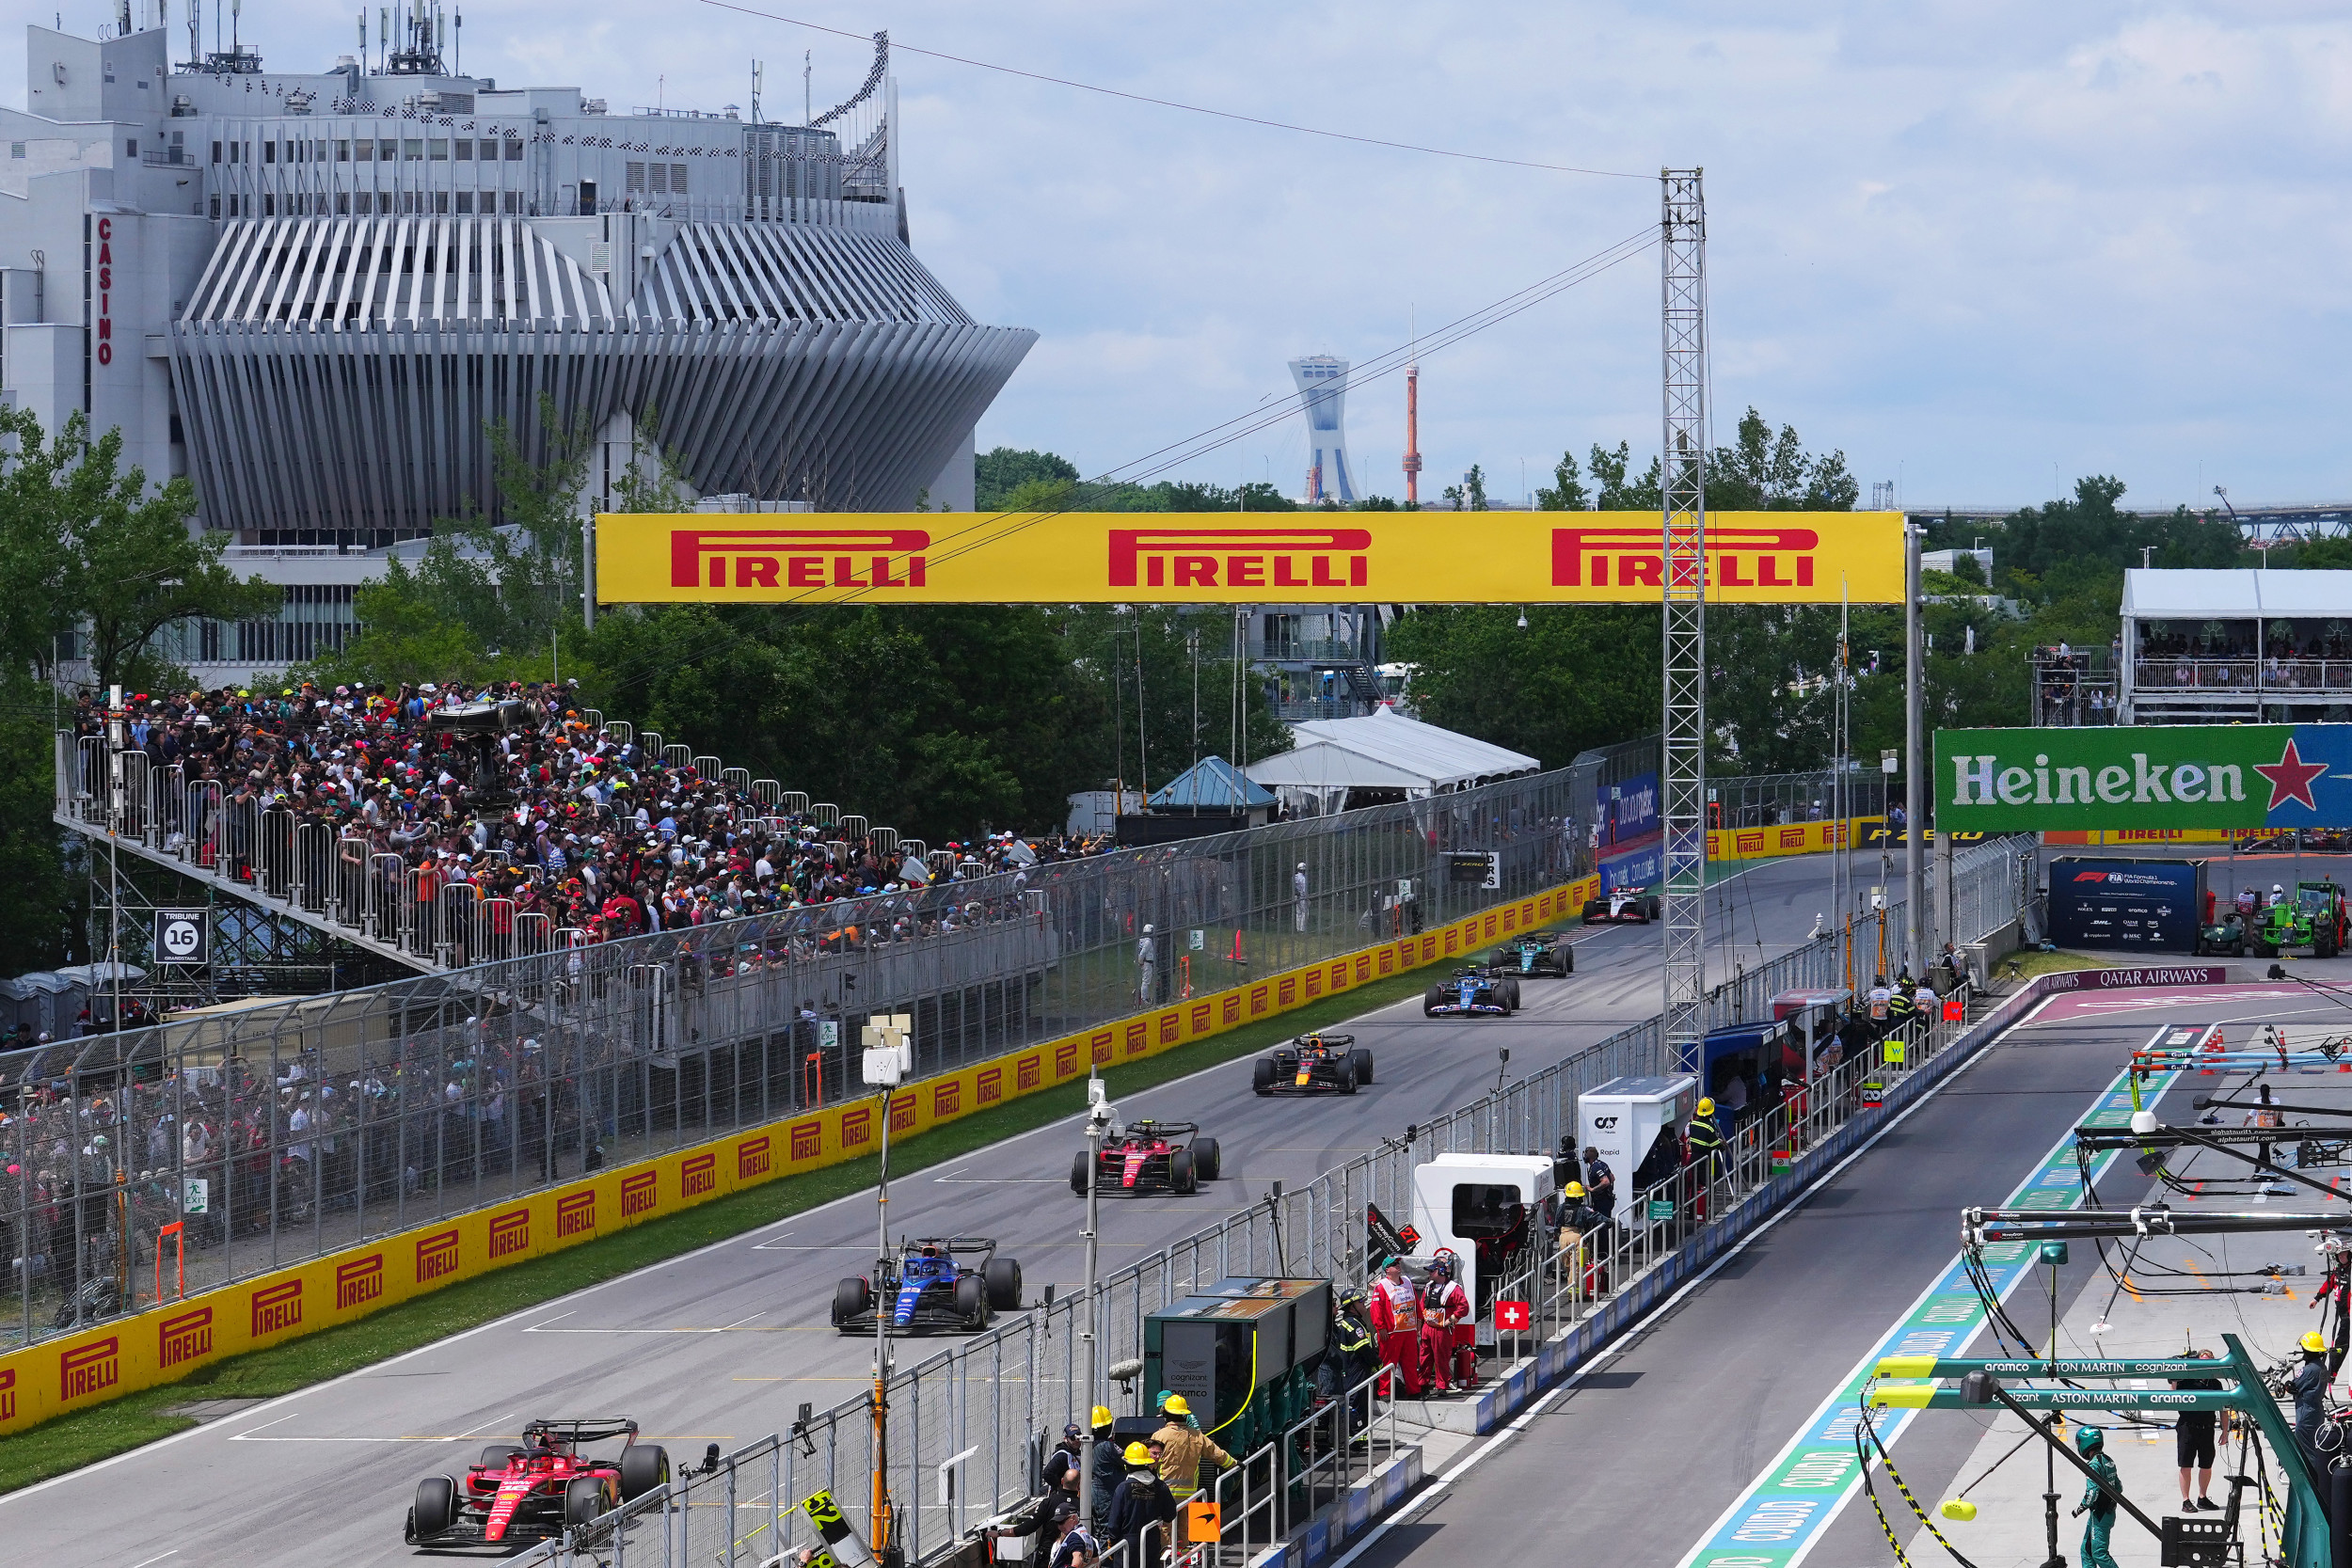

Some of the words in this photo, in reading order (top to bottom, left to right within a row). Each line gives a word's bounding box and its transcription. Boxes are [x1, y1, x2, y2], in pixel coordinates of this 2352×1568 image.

[99, 218, 112, 365] CASINO
[671, 530, 930, 588] PIRELLI
[1108, 530, 1372, 587] PIRELLI
[1551, 529, 1820, 587] PIRELLI
[1951, 753, 2247, 806] Heineken
[1737, 832, 1765, 854] PIRELLI
[1780, 829, 1805, 848] PIRELLI
[1823, 824, 1847, 844] PIRELL
[2221, 829, 2285, 839] RELLI
[1466, 921, 1478, 945] PIRELLI
[1486, 915, 1497, 938] PIRELLI
[1503, 909, 1516, 931] PIRELLI
[169, 929, 194, 945] 16
[1422, 937, 1436, 960] PIRELLI
[1445, 929, 1457, 954] PIRELLI
[1357, 956, 1370, 981] PIRELLI
[1379, 949, 1393, 974] PIRELLI
[1400, 942, 1414, 967] PIRELLI
[1306, 970, 1321, 997] PIRELLI
[1331, 962, 1347, 990] PIRELLI
[2051, 973, 2079, 989] AIRWAYS
[2100, 970, 2142, 987] QATAR
[2145, 969, 2208, 985] AIRWAYS
[1251, 986, 1267, 1015] PIRELLI
[1279, 978, 1295, 1006] PIRELLI
[1192, 1004, 1211, 1034] PIRELLI
[1224, 995, 1240, 1024] PIRELLI
[1127, 1022, 1146, 1054] PIRELLI
[1160, 1013, 1179, 1044] PIRELLI
[1056, 1044, 1077, 1077] PIRELLI
[1091, 1032, 1112, 1064] PIRELLI
[977, 1069, 1001, 1104] PIRELLI
[1018, 1055, 1040, 1090] PIRELLI
[890, 1094, 916, 1132] PIRELLI
[934, 1081, 960, 1117] PIRELLI
[791, 1121, 821, 1161] PIRELLI
[842, 1108, 870, 1148] PIRELLI
[2217, 1135, 2277, 1144] alphataurif1.com
[739, 1136, 770, 1180] PIRELLI
[682, 1153, 715, 1198] PIRELLI
[621, 1170, 657, 1220] PIRELLI
[557, 1190, 596, 1238] PIRELLI
[489, 1209, 529, 1259] PIRELLI
[1375, 1221, 1400, 1252] MoneyGram
[1400, 1227, 1421, 1243] 27
[417, 1229, 459, 1283] PIRELLI
[337, 1254, 383, 1309] PIRELLI
[252, 1279, 302, 1337] PIRELLI
[159, 1307, 213, 1369] PIRELLI
[61, 1337, 119, 1401] PIRELLI
[2081, 1362, 2125, 1372] MARTIN
[2136, 1362, 2188, 1373] cognizant
[2051, 1394, 2090, 1403] ASTON
[2093, 1394, 2138, 1403] MARTIN
[2151, 1394, 2196, 1403] aramco
